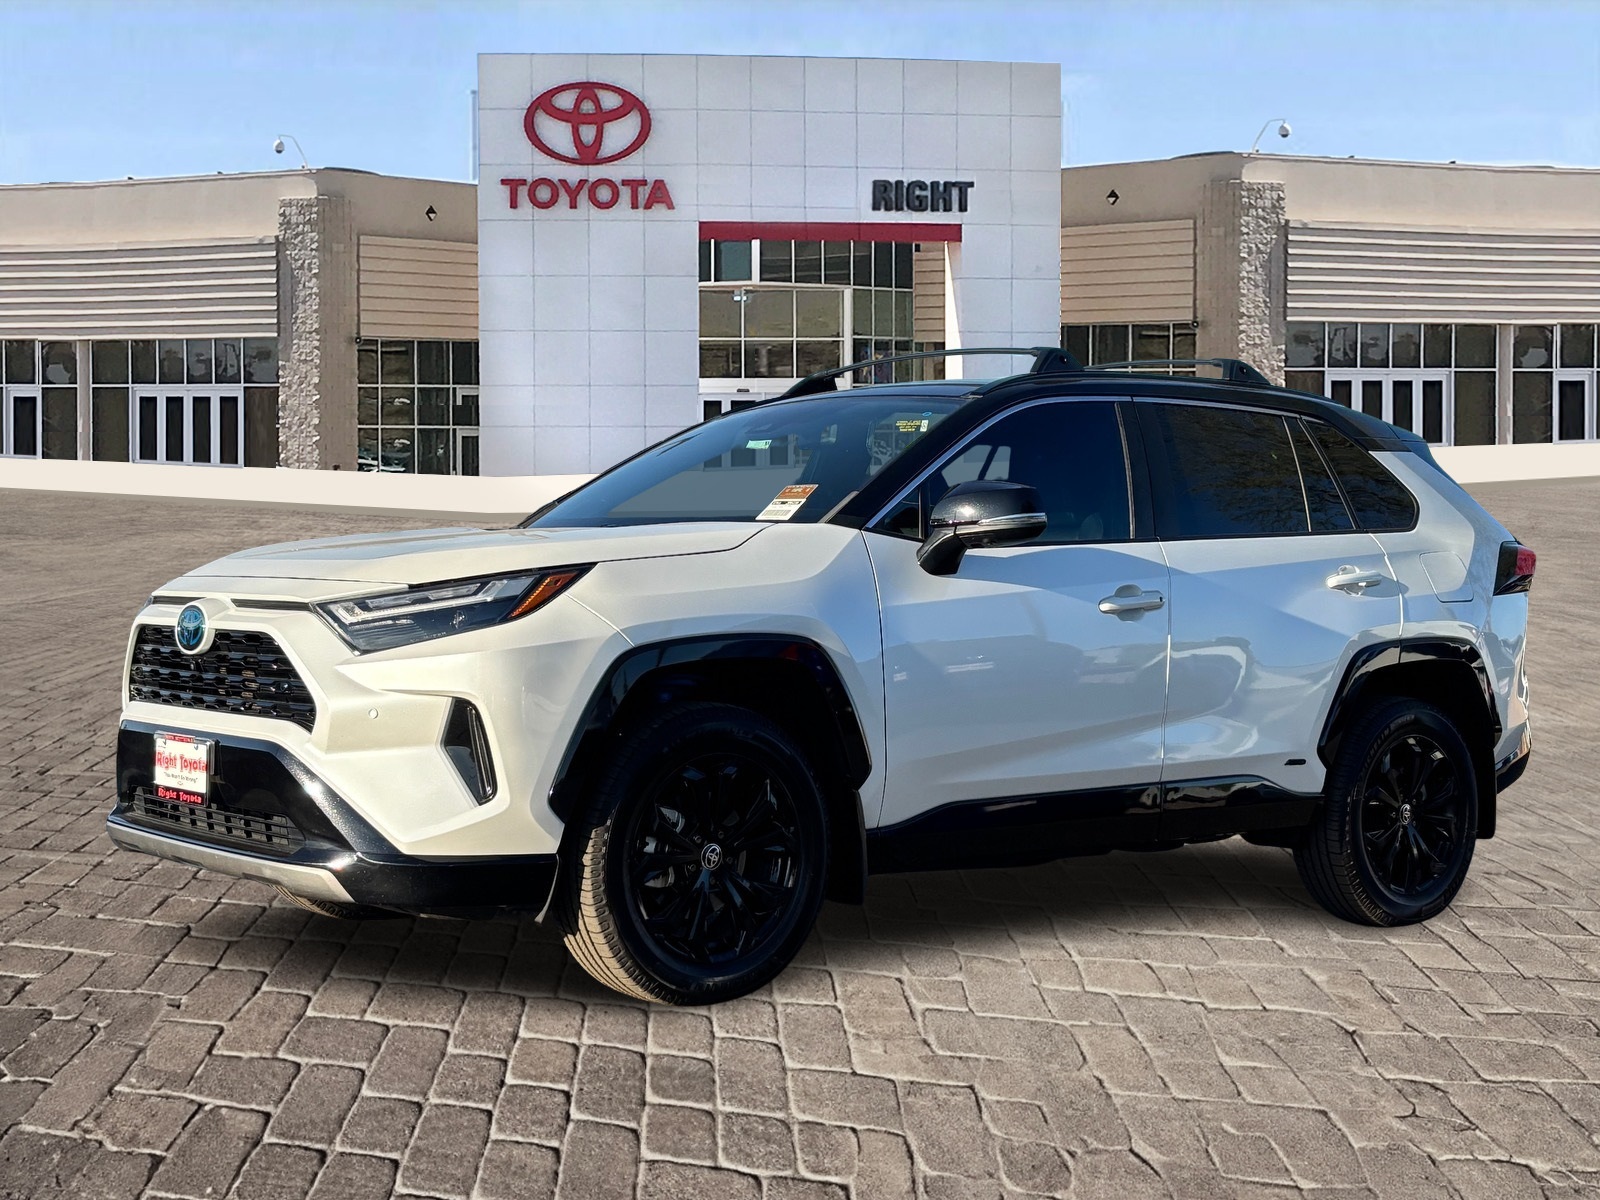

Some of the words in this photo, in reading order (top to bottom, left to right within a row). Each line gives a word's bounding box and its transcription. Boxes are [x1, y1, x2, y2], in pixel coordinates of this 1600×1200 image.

[500, 177, 675, 210] TOYOTA
[872, 179, 975, 212] RIGHT
[156, 751, 177, 769] Right
[179, 754, 208, 773] Toyota
[158, 787, 177, 799] Right
[179, 792, 202, 803] Toyota
